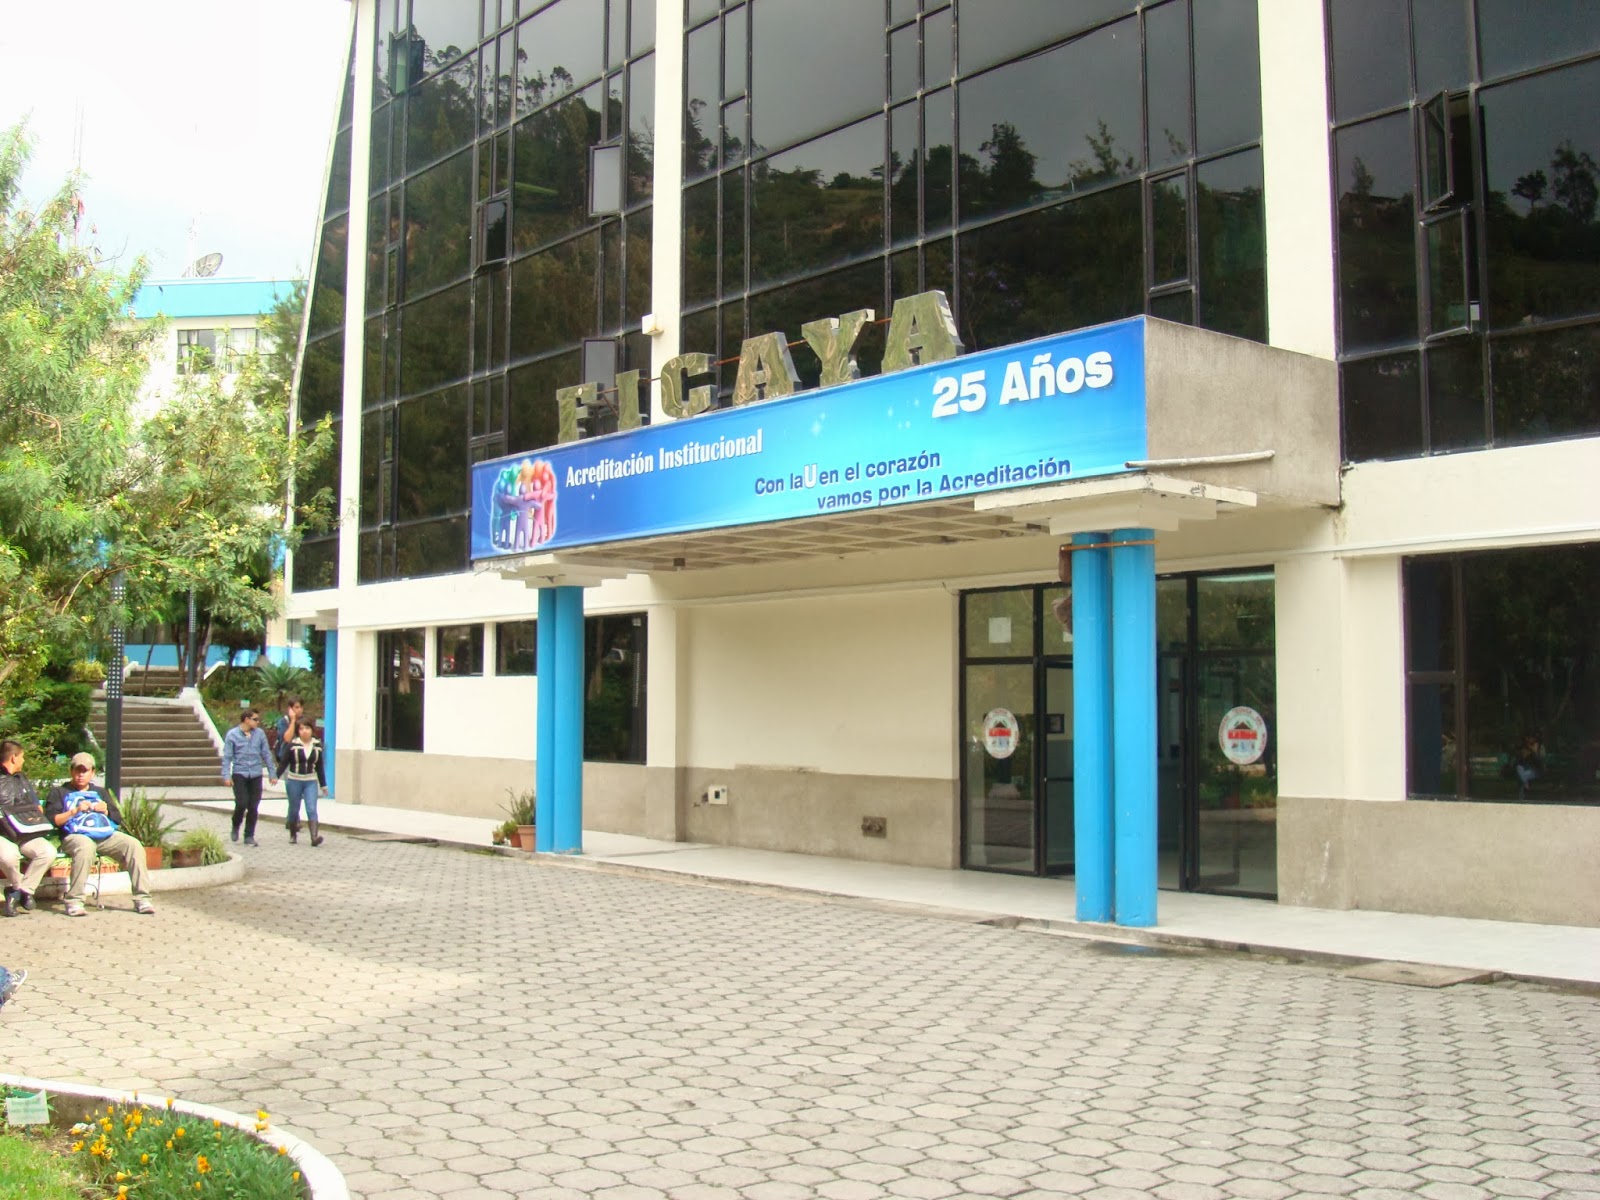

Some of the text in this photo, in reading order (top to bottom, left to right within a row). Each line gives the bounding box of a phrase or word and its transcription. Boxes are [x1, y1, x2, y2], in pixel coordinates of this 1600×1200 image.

[556, 290, 964, 444] FICAYA
[931, 351, 1114, 418] 25 Años
[565, 428, 763, 488] Acreditación Institucional
[754, 477, 785, 496] Con
[819, 469, 839, 486] en
[844, 462, 860, 482] el
[865, 450, 941, 479] corazón
[817, 457, 1072, 510] vamos por la Acreditación
